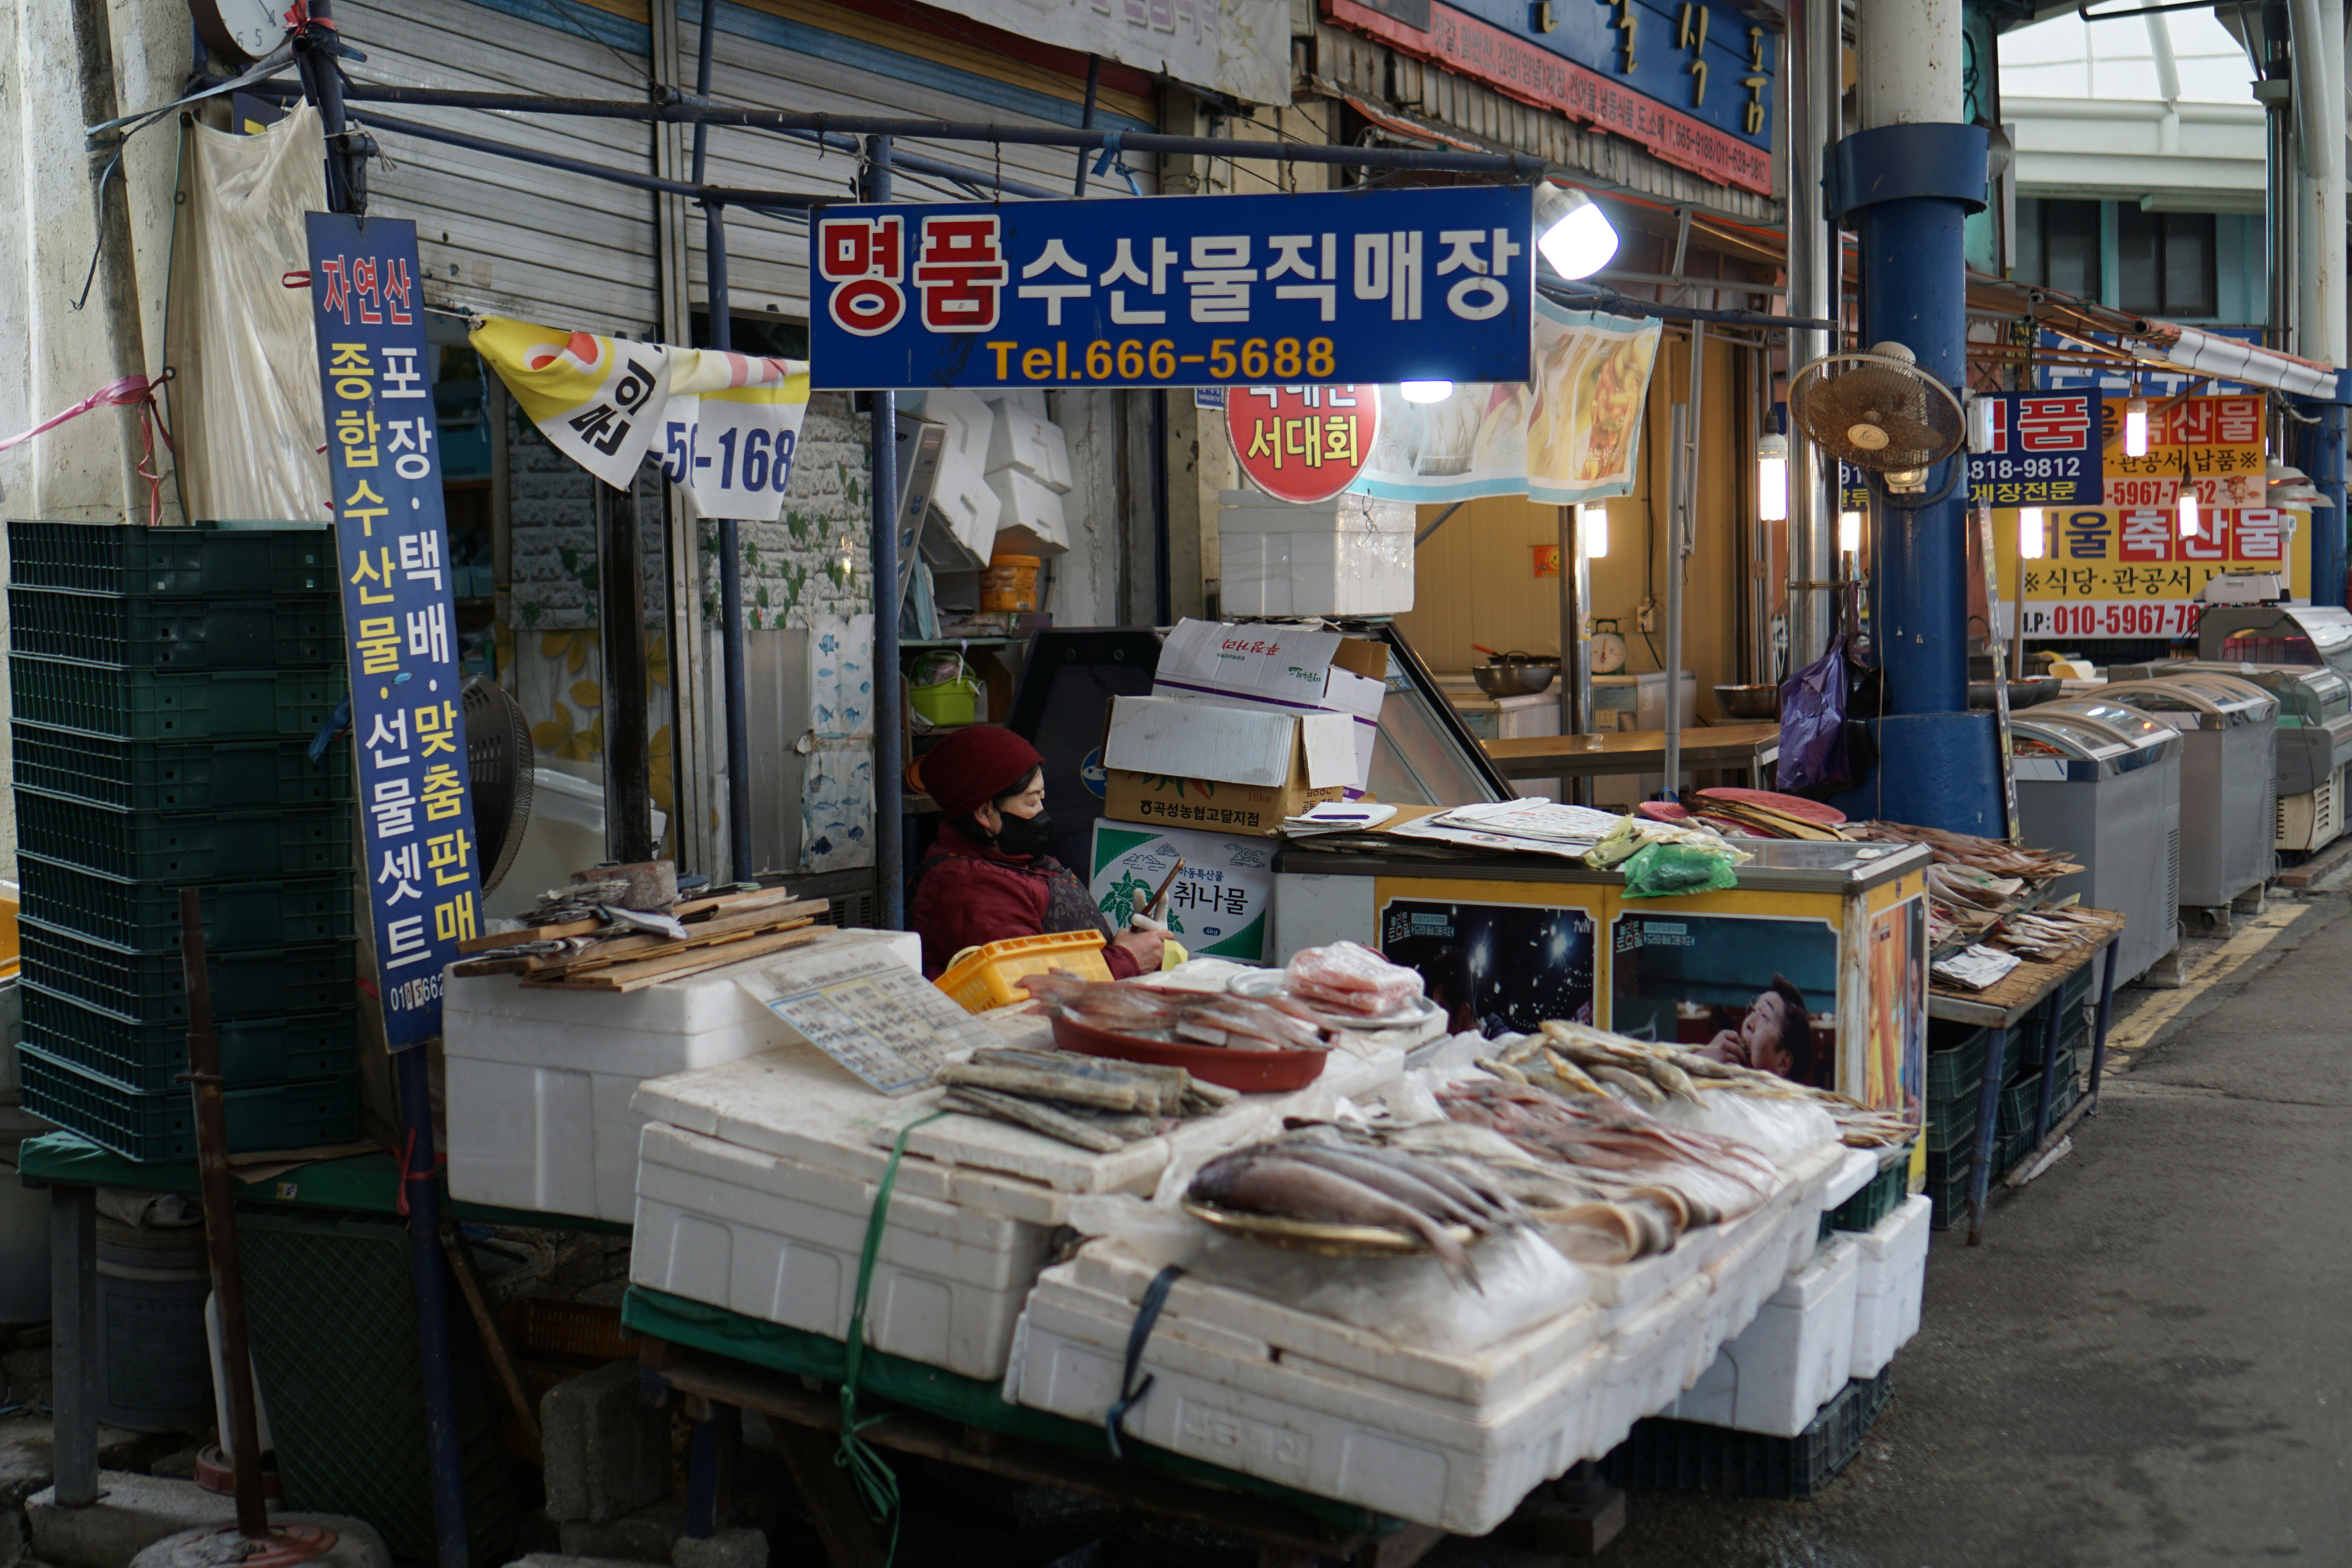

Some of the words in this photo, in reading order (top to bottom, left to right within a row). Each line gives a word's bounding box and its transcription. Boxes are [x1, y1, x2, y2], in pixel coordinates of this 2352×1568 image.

[255, 28, 262, 47] 5
[818, 215, 1008, 336] 명품
[321, 255, 413, 325] 자연산
[987, 337, 1335, 381] Tel.666-5688
[1248, 415, 1358, 469] 서대회
[1967, 457, 2080, 480] 818-9812
[1247, 792, 1272, 804] 10kg
[1154, 804, 1260, 827] 곡성농협고달지점
[1174, 881, 1248, 915] 취나물
[1573, 918, 1591, 933] tvN
